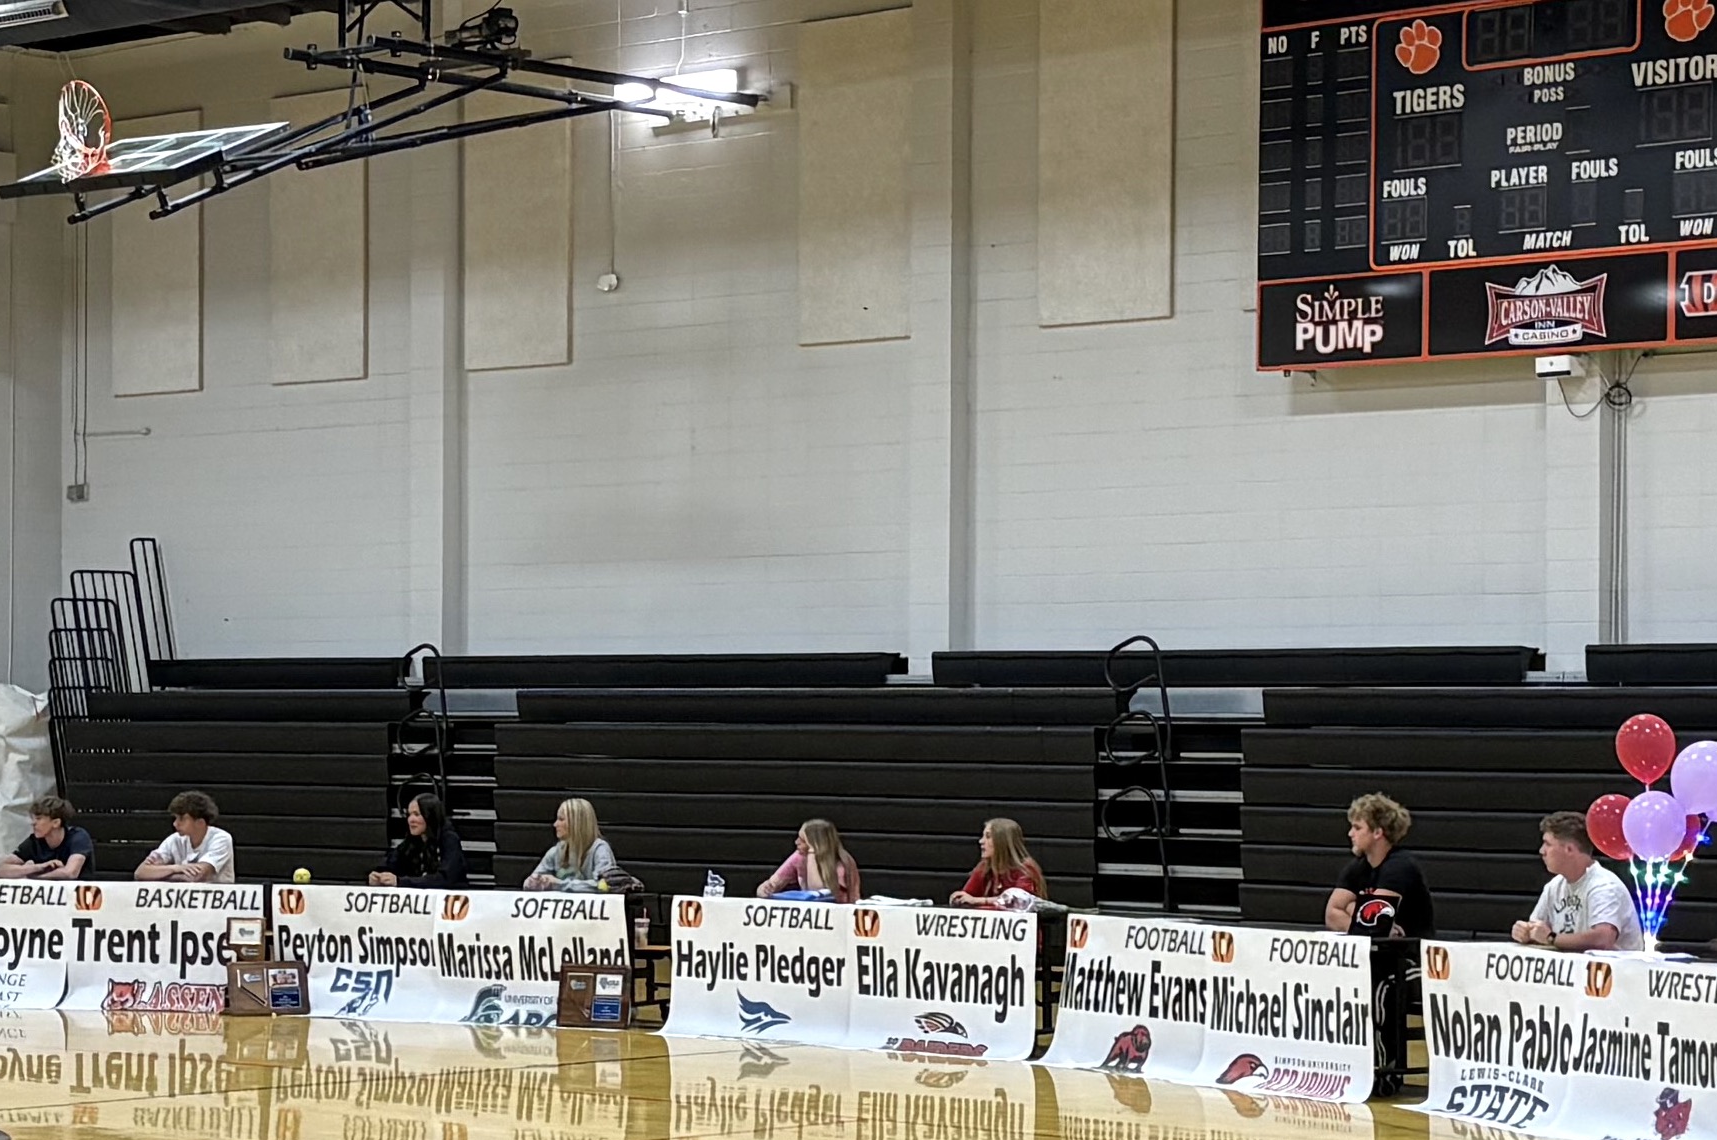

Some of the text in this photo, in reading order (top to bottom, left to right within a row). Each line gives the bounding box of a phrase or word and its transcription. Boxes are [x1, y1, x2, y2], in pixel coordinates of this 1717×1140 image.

[1267, 35, 1288, 54] NO
[1311, 31, 1320, 50] F
[1339, 24, 1368, 46] PTS
[1523, 62, 1575, 85] BONUS
[1393, 84, 1465, 114] TIGERS
[1533, 86, 1565, 104] POSS
[1505, 122, 1564, 146] PERIOD
[1490, 157, 1619, 188] PLAYER FOULS
[1382, 176, 1427, 198] FOULS
[1523, 229, 1572, 250] MATCH
[1618, 224, 1649, 245] TOL
[1679, 218, 1713, 237] WON
[1389, 243, 1419, 261] WON
[1447, 238, 1477, 259] TOL
[1295, 294, 1384, 323] SIMPLE
[1295, 320, 1384, 355] PUMP
[1522, 329, 1569, 341] CASINO
[1535, 320, 1555, 330] INN
[135, 888, 261, 911] BASKETBALL
[344, 892, 432, 916] SOFTBALL
[511, 897, 610, 921] SOFTBALL
[743, 905, 834, 930] SOFTBALL
[916, 914, 1028, 941] WRESTLING
[71, 918, 161, 965] Trent
[278, 924, 352, 974] Peyton
[1125, 926, 1206, 956] FOOTBALL
[1270, 938, 1360, 968] FOOTBALL
[437, 932, 514, 981] Marissa
[676, 940, 845, 997] Haylie Pledger
[1485, 953, 1574, 987] FOOTBALL
[134, 980, 225, 1013] LASSEN
[857, 945, 1025, 1023] Ella Kavanagh
[1060, 952, 1207, 1025] Matthew Evans
[504, 995, 553, 1005] UNIVERSITY OF
[1210, 977, 1369, 1046] Michael Sinclair
[1430, 993, 1572, 1075] Nolan Pablo
[1573, 1013, 1650, 1081] Jasmine
[1461, 1068, 1544, 1093] LEWIS-CLARK
[1446, 1085, 1549, 1129] STATE
